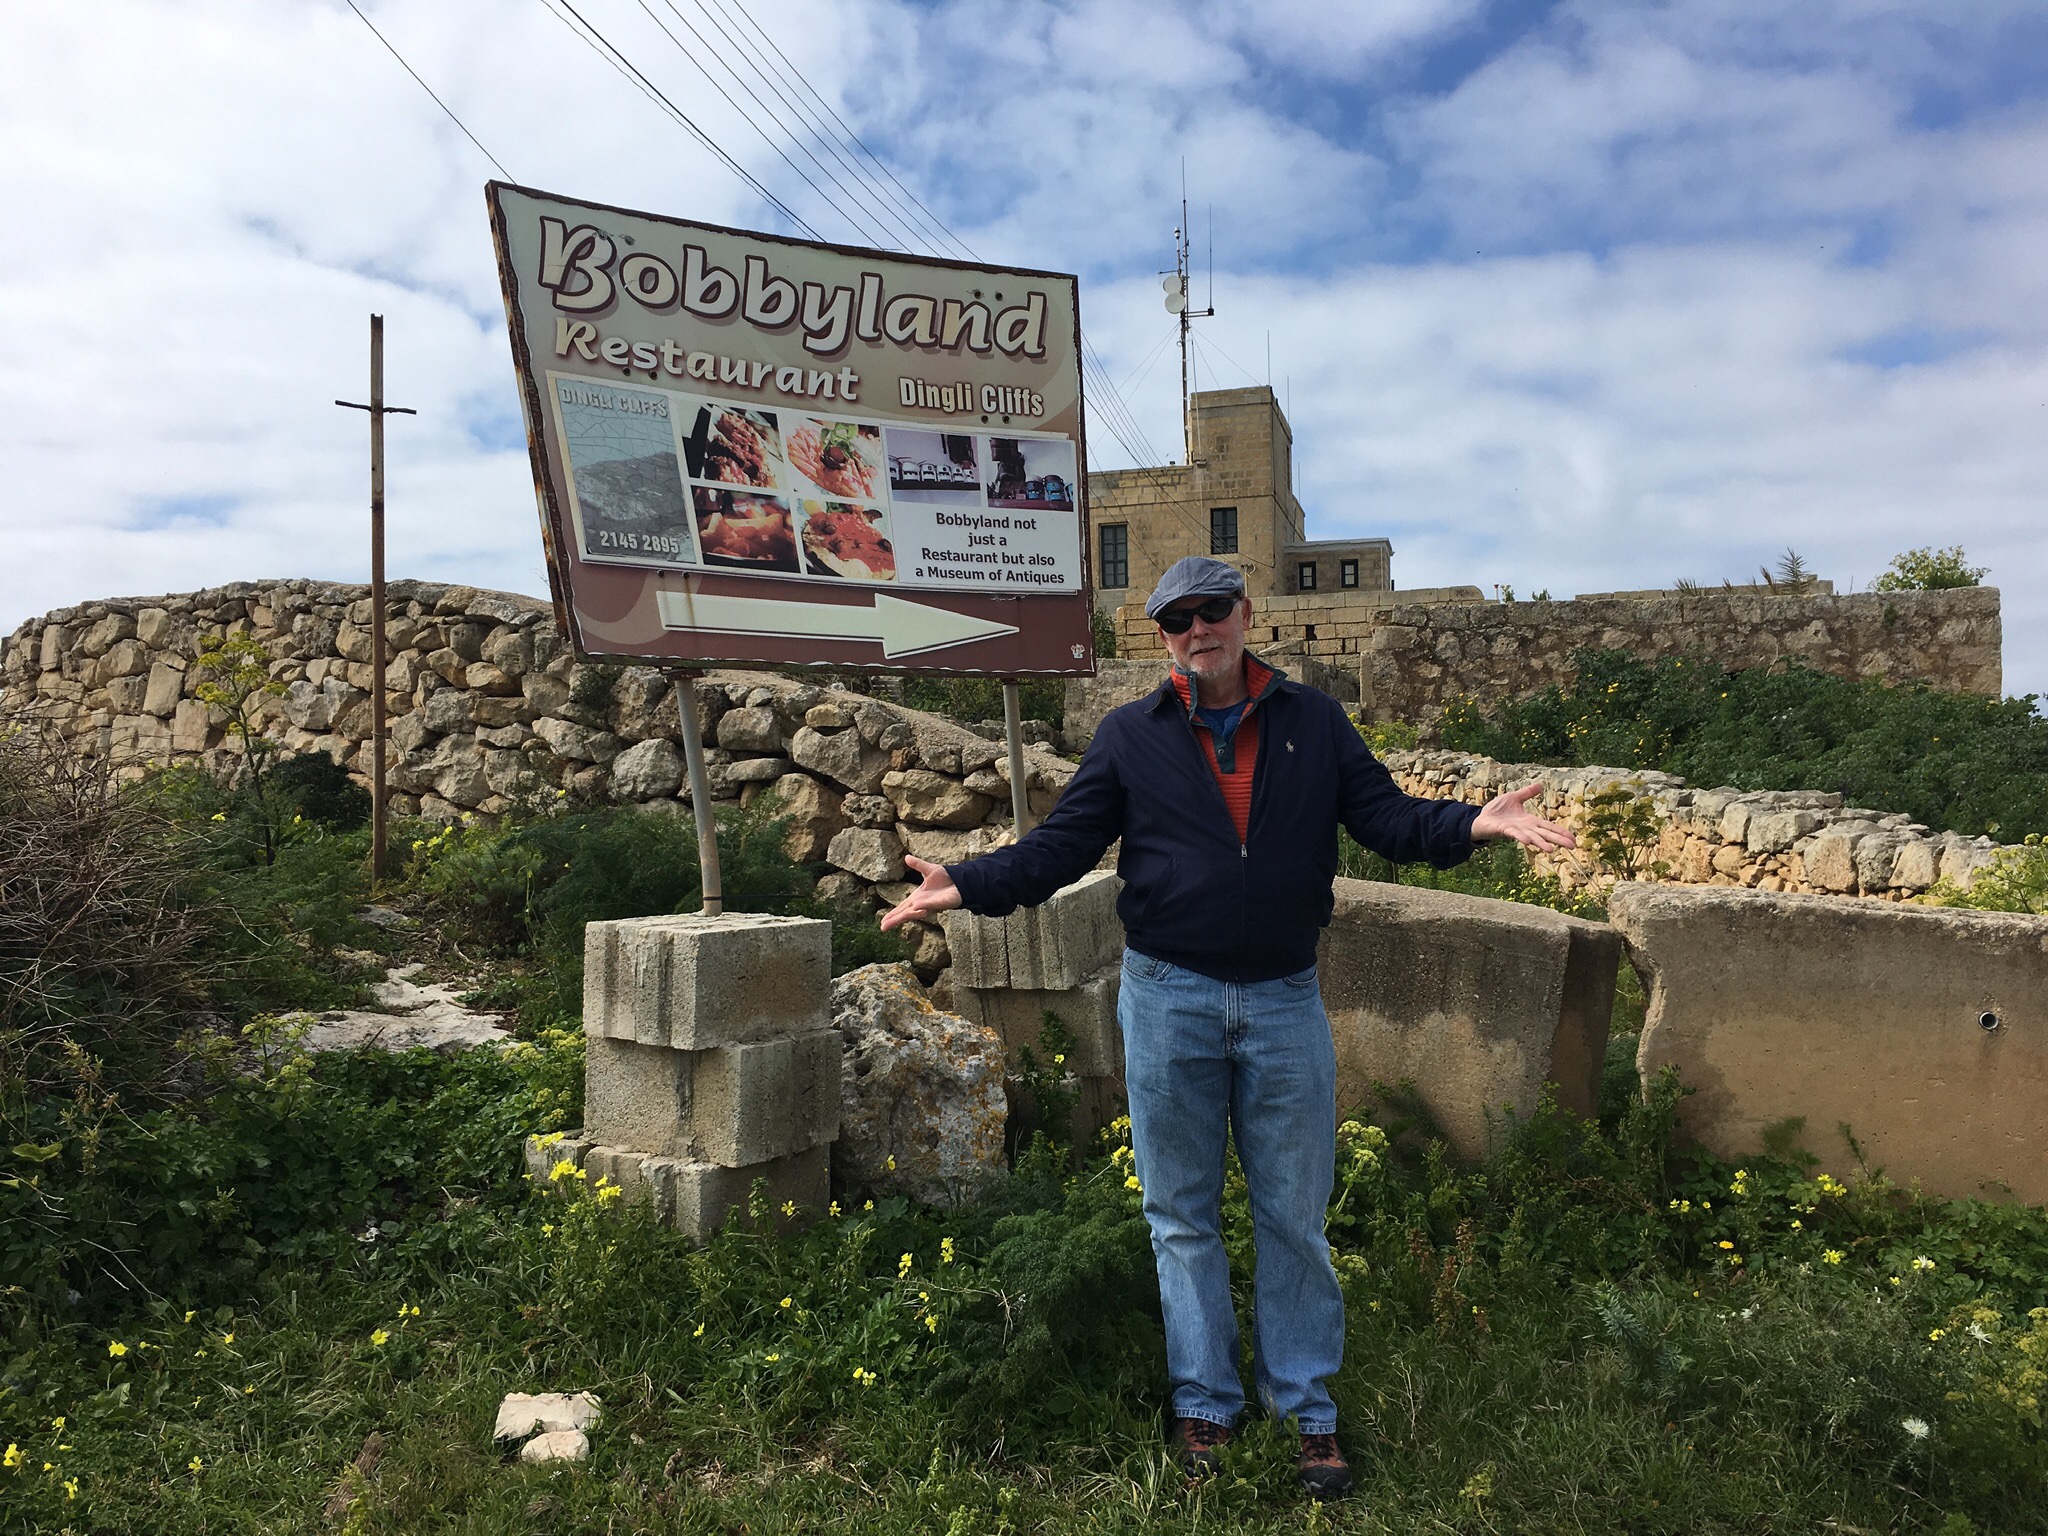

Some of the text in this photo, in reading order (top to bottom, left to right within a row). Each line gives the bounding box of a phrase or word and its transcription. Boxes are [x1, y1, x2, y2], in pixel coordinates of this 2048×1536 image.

[539, 216, 1047, 358] Bobbyland
[555, 318, 860, 401] Restaurant
[560, 387, 668, 419] DINGLI CLIFFS
[900, 378, 1045, 417] Dingli Cliffs
[936, 512, 1037, 530] Bobbyland not
[600, 530, 680, 554] 2145 2895
[968, 532, 1008, 547] just a
[921, 547, 1055, 567] Restaurant but also
[915, 566, 1065, 586] a Museum of Antiques
